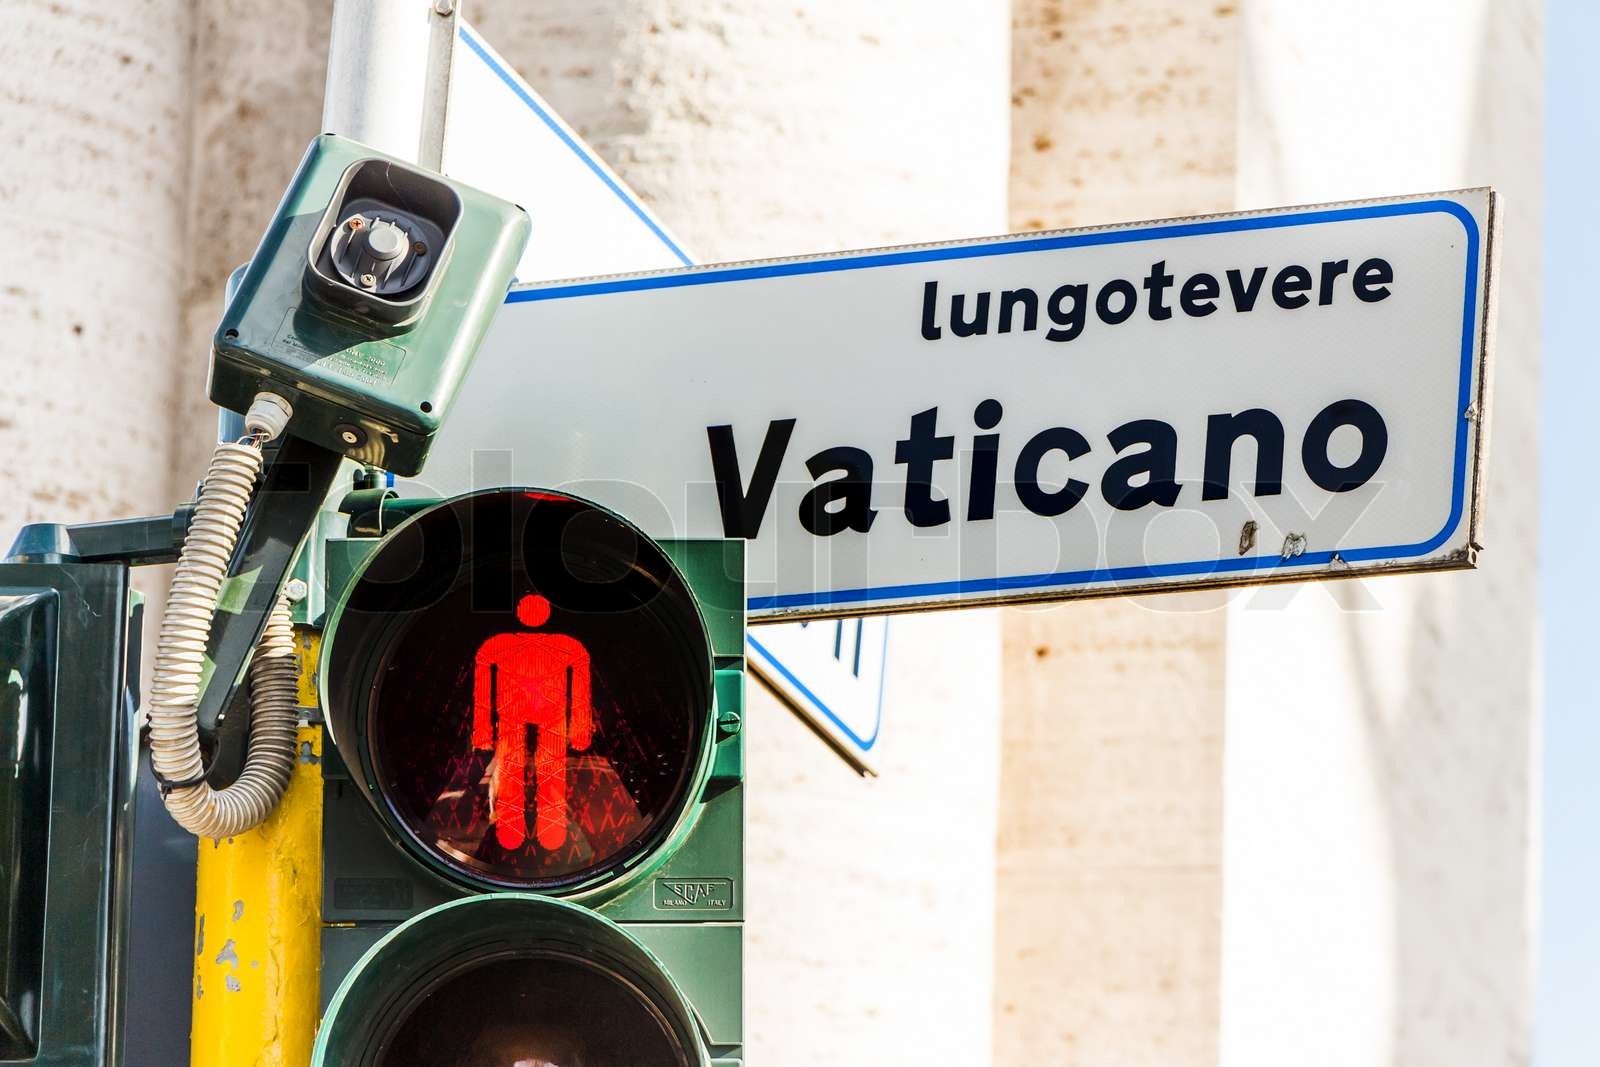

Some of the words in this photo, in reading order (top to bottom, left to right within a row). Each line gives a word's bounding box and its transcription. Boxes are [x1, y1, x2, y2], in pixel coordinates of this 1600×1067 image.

[920, 257, 1395, 343] lungotevere
[706, 398, 1389, 539] Vaticano
[707, 899, 728, 907] ITALY
